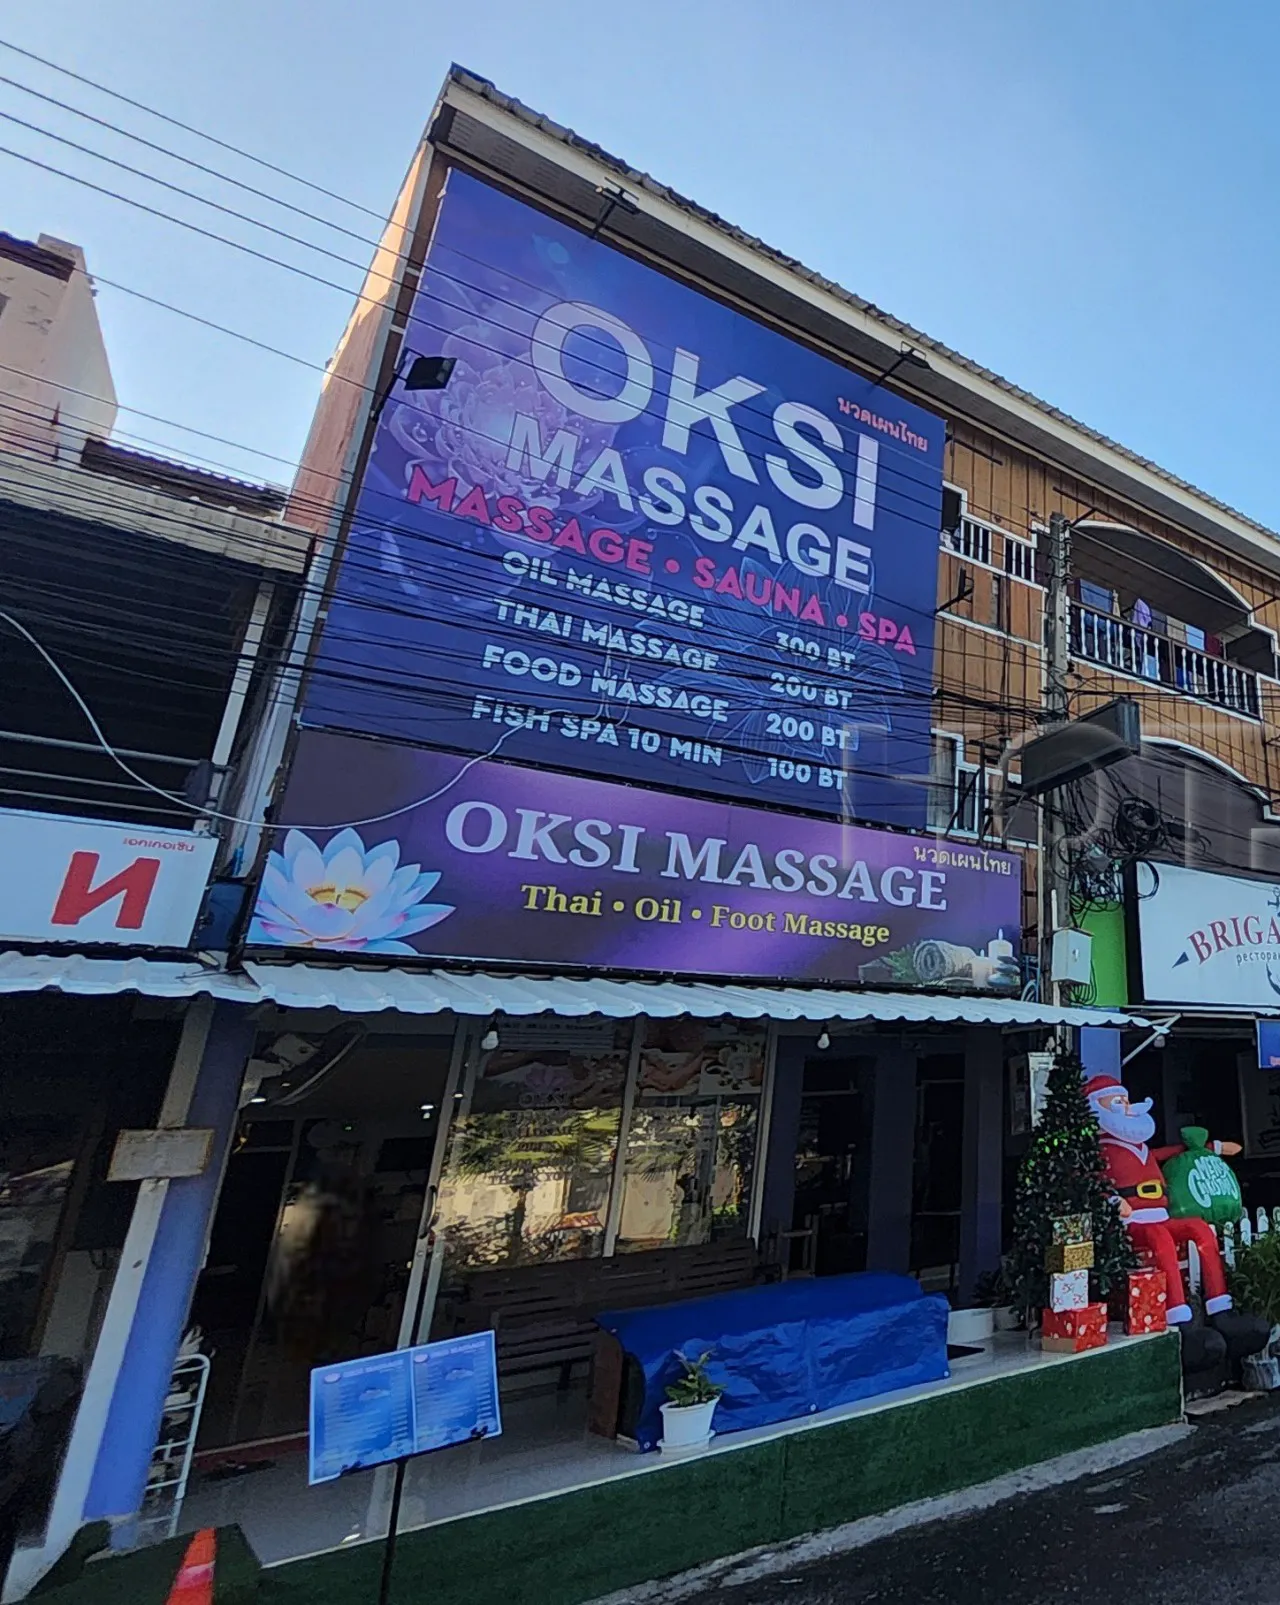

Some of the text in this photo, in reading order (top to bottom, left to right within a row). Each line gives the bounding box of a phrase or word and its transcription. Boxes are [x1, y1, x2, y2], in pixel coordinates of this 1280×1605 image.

[532, 301, 879, 530] OKSI
[506, 411, 873, 595] MASSAGE
[407, 464, 916, 656] MASSAGE SAUNA SPA
[502, 551, 557, 585] OIL
[566, 568, 705, 628] MASSAGE
[828, 647, 855, 671] BT
[482, 644, 850, 749] FOOD MASSAGE 200 BT
[494, 598, 853, 709] THAI MASSAGE 200 BT
[471, 695, 848, 790] FISH SPA 10 MIN 100 BT
[446, 801, 946, 911] OKSI MASSAGE
[521, 884, 890, 947] Thai Oil Foot Massage
